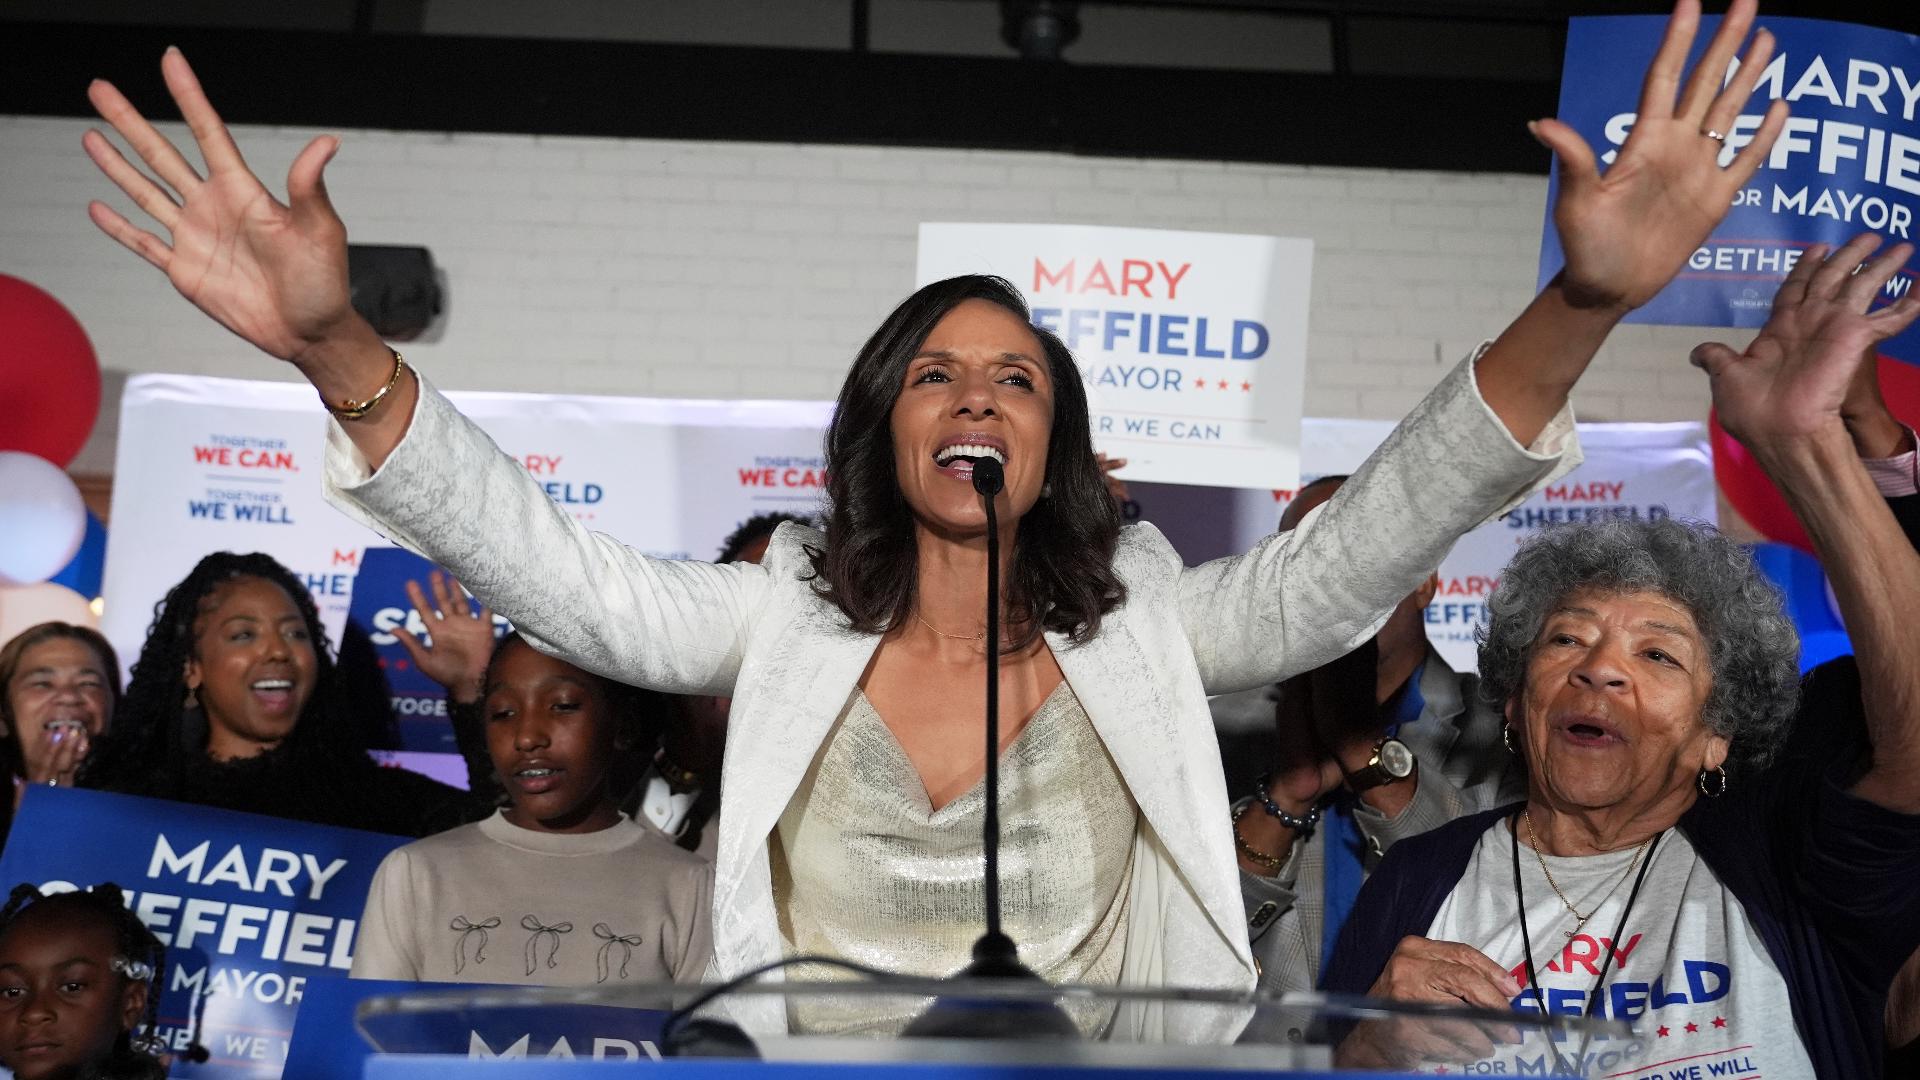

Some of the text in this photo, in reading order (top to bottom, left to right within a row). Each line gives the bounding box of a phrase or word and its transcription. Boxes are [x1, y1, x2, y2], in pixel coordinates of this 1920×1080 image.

[1771, 183, 1912, 239] MAYOR
[1033, 256, 1192, 300] MARY
[1124, 418, 1159, 437] WE
[1170, 421, 1221, 440] CAN
[193, 446, 299, 472] WE CAN.
[738, 467, 776, 487] WE
[1545, 480, 1624, 501] MARY
[189, 500, 294, 525] WE WILL
[148, 833, 348, 900] MARY
[225, 1034, 269, 1060] WE
[1707, 1057, 1758, 1077] WILL
